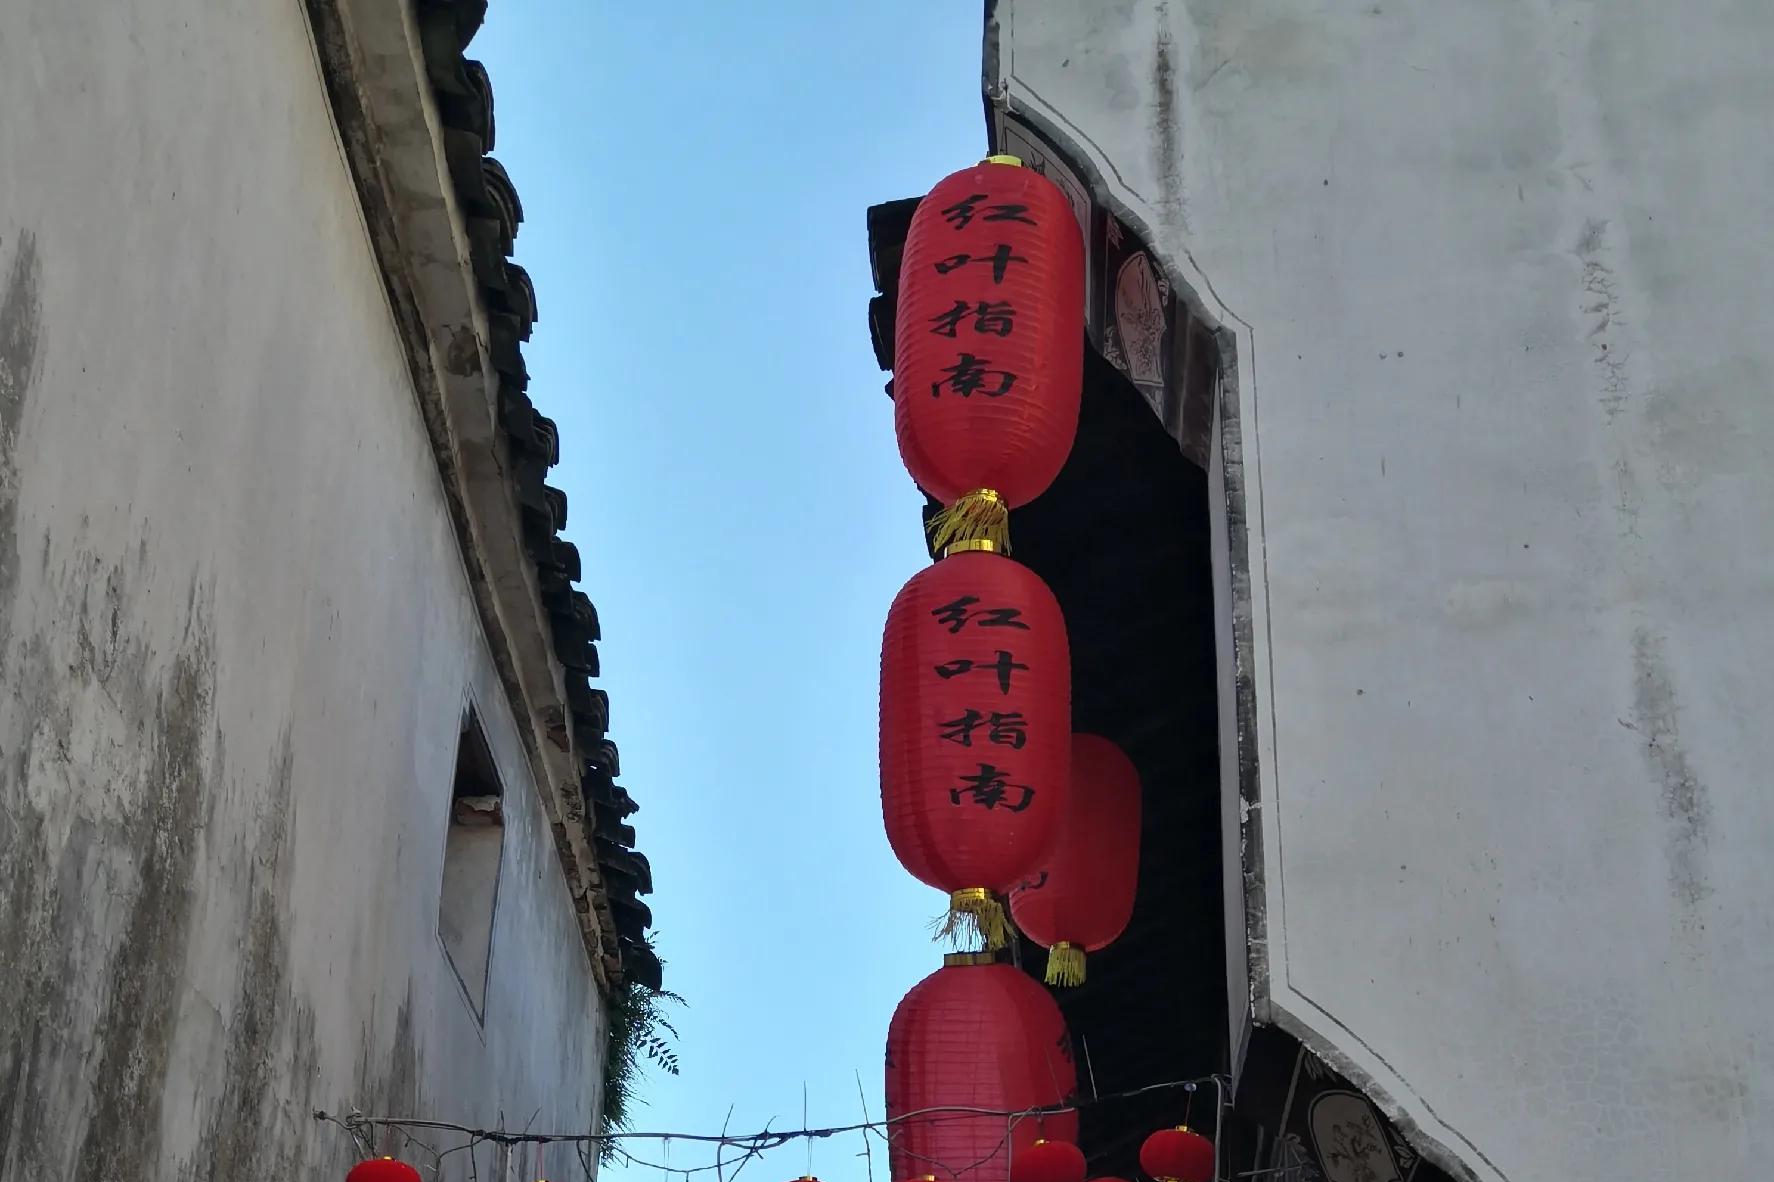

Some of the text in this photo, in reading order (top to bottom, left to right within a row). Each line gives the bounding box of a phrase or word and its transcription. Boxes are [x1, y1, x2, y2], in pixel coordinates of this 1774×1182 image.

[928, 194, 1038, 398] 红叶指南
[931, 595, 1036, 813] 红叶指南
